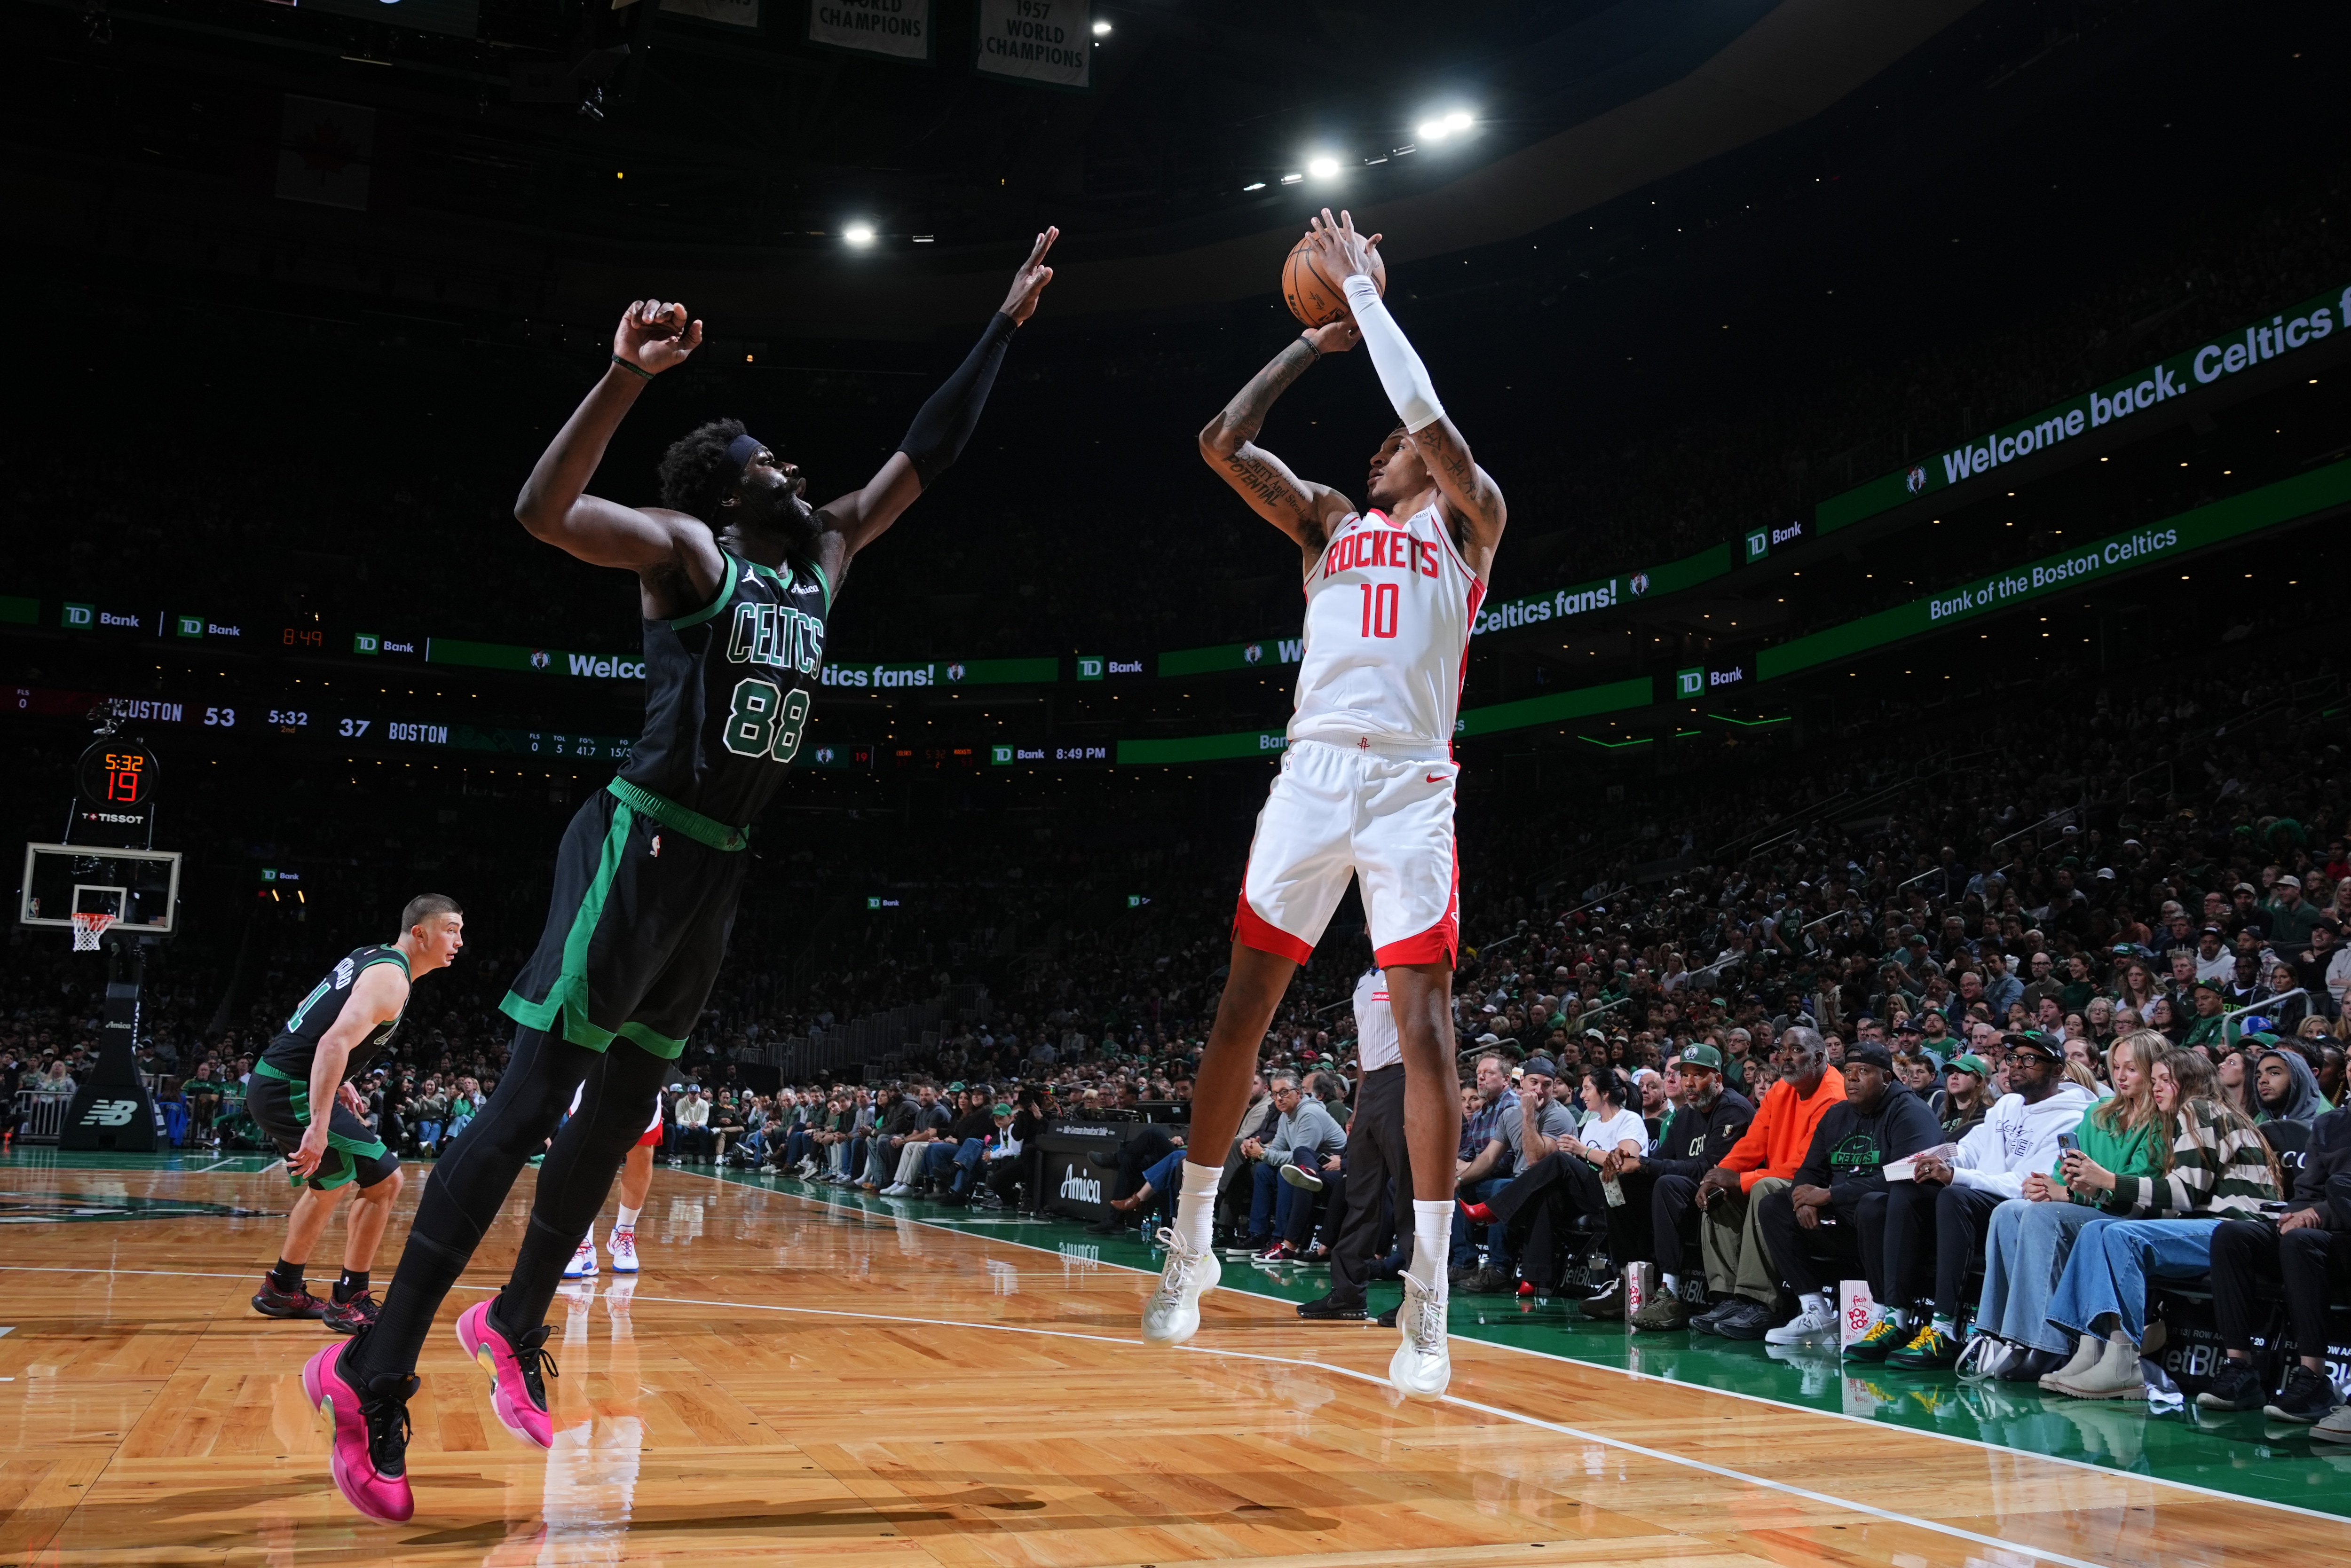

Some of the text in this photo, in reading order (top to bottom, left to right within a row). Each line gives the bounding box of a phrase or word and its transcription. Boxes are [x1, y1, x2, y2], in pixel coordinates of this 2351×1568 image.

[1016, 0, 1051, 20] 1957
[820, 7, 921, 38] CHAMPIONS
[1007, 19, 1065, 44] WORLD
[987, 36, 1082, 68] CHAMPIONS
[1943, 308, 2332, 483] Welcome back. Celtics
[1223, 454, 1278, 506] POTENTIAL
[1270, 481, 1289, 497] And
[1748, 521, 1801, 555] TD Bank
[1324, 530, 1439, 580] ROCKETS
[1931, 529, 2177, 620] Bank of the Boston Celtics
[66, 607, 139, 627] TD Bank
[1361, 583, 1399, 638] 10
[1472, 580, 1616, 634] Celtics fans!
[181, 620, 239, 636] TD Bank
[284, 629, 322, 646] 8:49
[357, 637, 413, 652] TD Bank
[726, 602, 823, 680] CELTCS
[569, 654, 934, 686] Welco tics fans!
[1080, 661, 1142, 676] TD Bank
[1680, 667, 1742, 693] TD Bank
[19, 699, 26, 708] 0
[109, 698, 447, 743] USTON 53 5:32 37 BOSTON
[723, 678, 810, 763] 88
[532, 742, 632, 758] 0 5 41.7 15/3
[1260, 735, 1290, 749] Ban
[106, 754, 143, 772] 5:32
[856, 753, 868, 761] 19
[995, 749, 1044, 761] TD Bank
[1057, 748, 1105, 759] 8:49 PM
[108, 772, 137, 801] 19
[99, 813, 143, 824] TISSOT
[263, 870, 275, 879] TD
[332, 957, 355, 990] TCHARD
[80, 1100, 137, 1126] NB
[1837, 1152, 1872, 1164] CELTICS
[1061, 1164, 1100, 1204] Amica
[1560, 1263, 1592, 1288] jetBl
[1853, 1295, 1866, 1306] fresh
[1848, 1308, 1866, 1320] POP
[2193, 1329, 2212, 1339] ROW
[2253, 1337, 2264, 1346] 20
[2166, 1344, 2224, 1379] etBl
